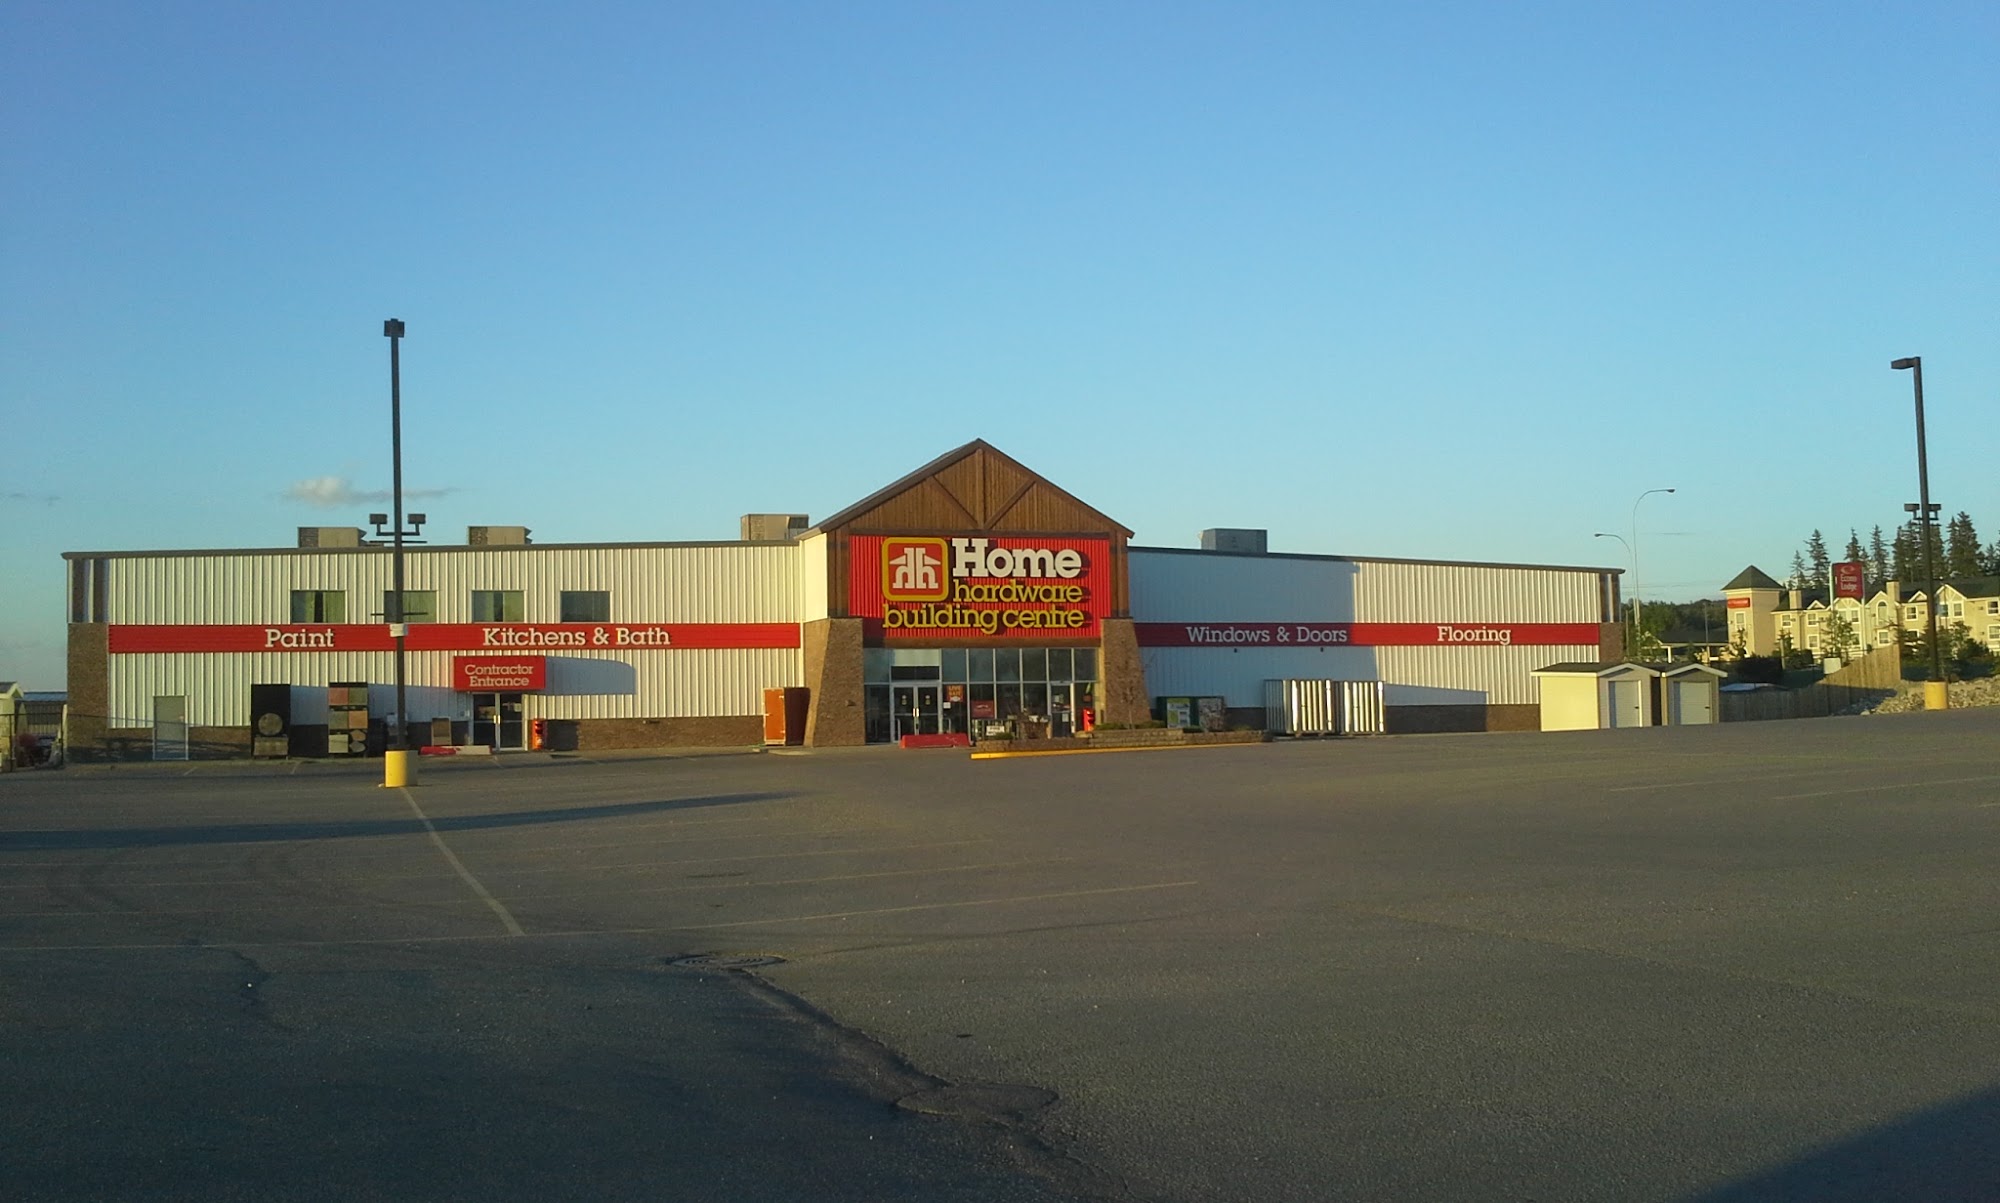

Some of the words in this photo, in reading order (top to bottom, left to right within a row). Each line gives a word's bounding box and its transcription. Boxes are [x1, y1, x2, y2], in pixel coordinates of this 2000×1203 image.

[951, 537, 1082, 578] Home
[952, 578, 1083, 603] hardware
[882, 603, 999, 635] building
[1002, 604, 1085, 629] centre
[264, 628, 335, 648] Paint
[482, 627, 586, 646] Kitchens
[592, 626, 610, 646] &
[615, 627, 671, 646] Bath
[1185, 626, 1271, 643] Windows
[1276, 626, 1290, 643] &
[1296, 626, 1348, 643] Doors
[1436, 625, 1512, 646] Flooring
[464, 664, 534, 676] Contractor
[469, 675, 530, 688] Entrance
